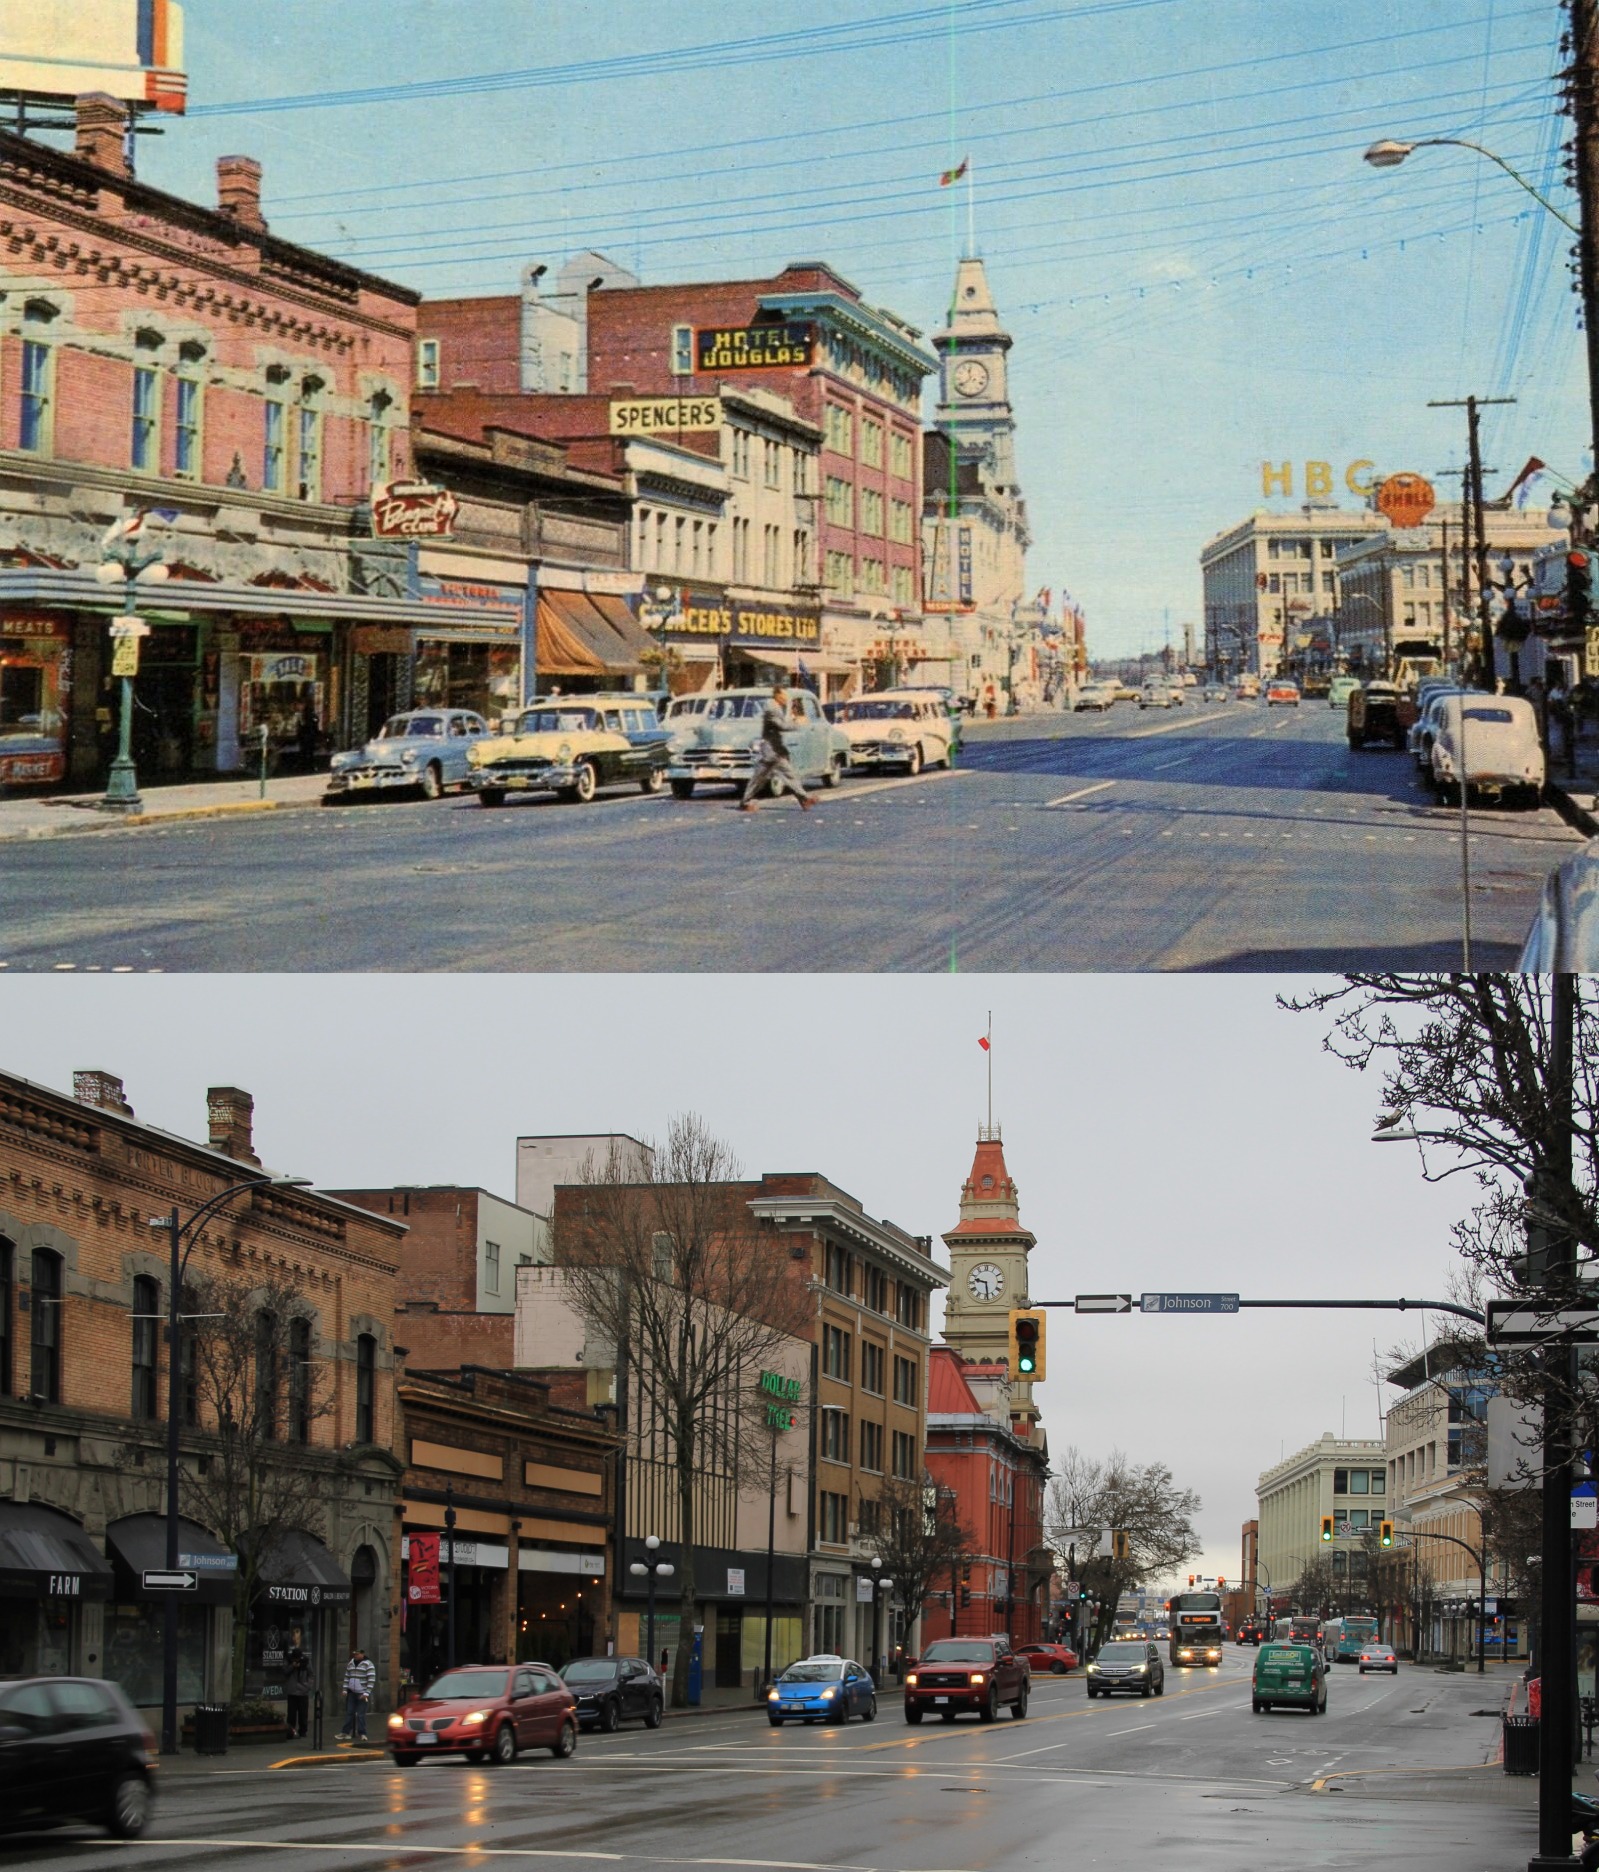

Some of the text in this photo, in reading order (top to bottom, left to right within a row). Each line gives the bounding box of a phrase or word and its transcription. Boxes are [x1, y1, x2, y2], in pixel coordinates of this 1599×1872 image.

[715, 329, 795, 349] HOTEL
[704, 347, 805, 367] DOUGLAS
[616, 402, 715, 429] SPENCER'S
[1262, 459, 1376, 497] HBC
[1384, 493, 1431, 507] SHELL
[2, 621, 54, 635] MEATS
[738, 611, 793, 638] STORES
[128, 1147, 217, 1194] PORTER BLOCK
[1163, 1296, 1211, 1310] Johnson
[1220, 1303, 1234, 1311] 700
[761, 1369, 801, 1400] DOLLAR
[193, 1555, 226, 1566] Johnson
[50, 1576, 80, 1595] FARM
[269, 1586, 308, 1601] STATION
[263, 1650, 284, 1660] STATION
[262, 1685, 283, 1696] AVEDA
